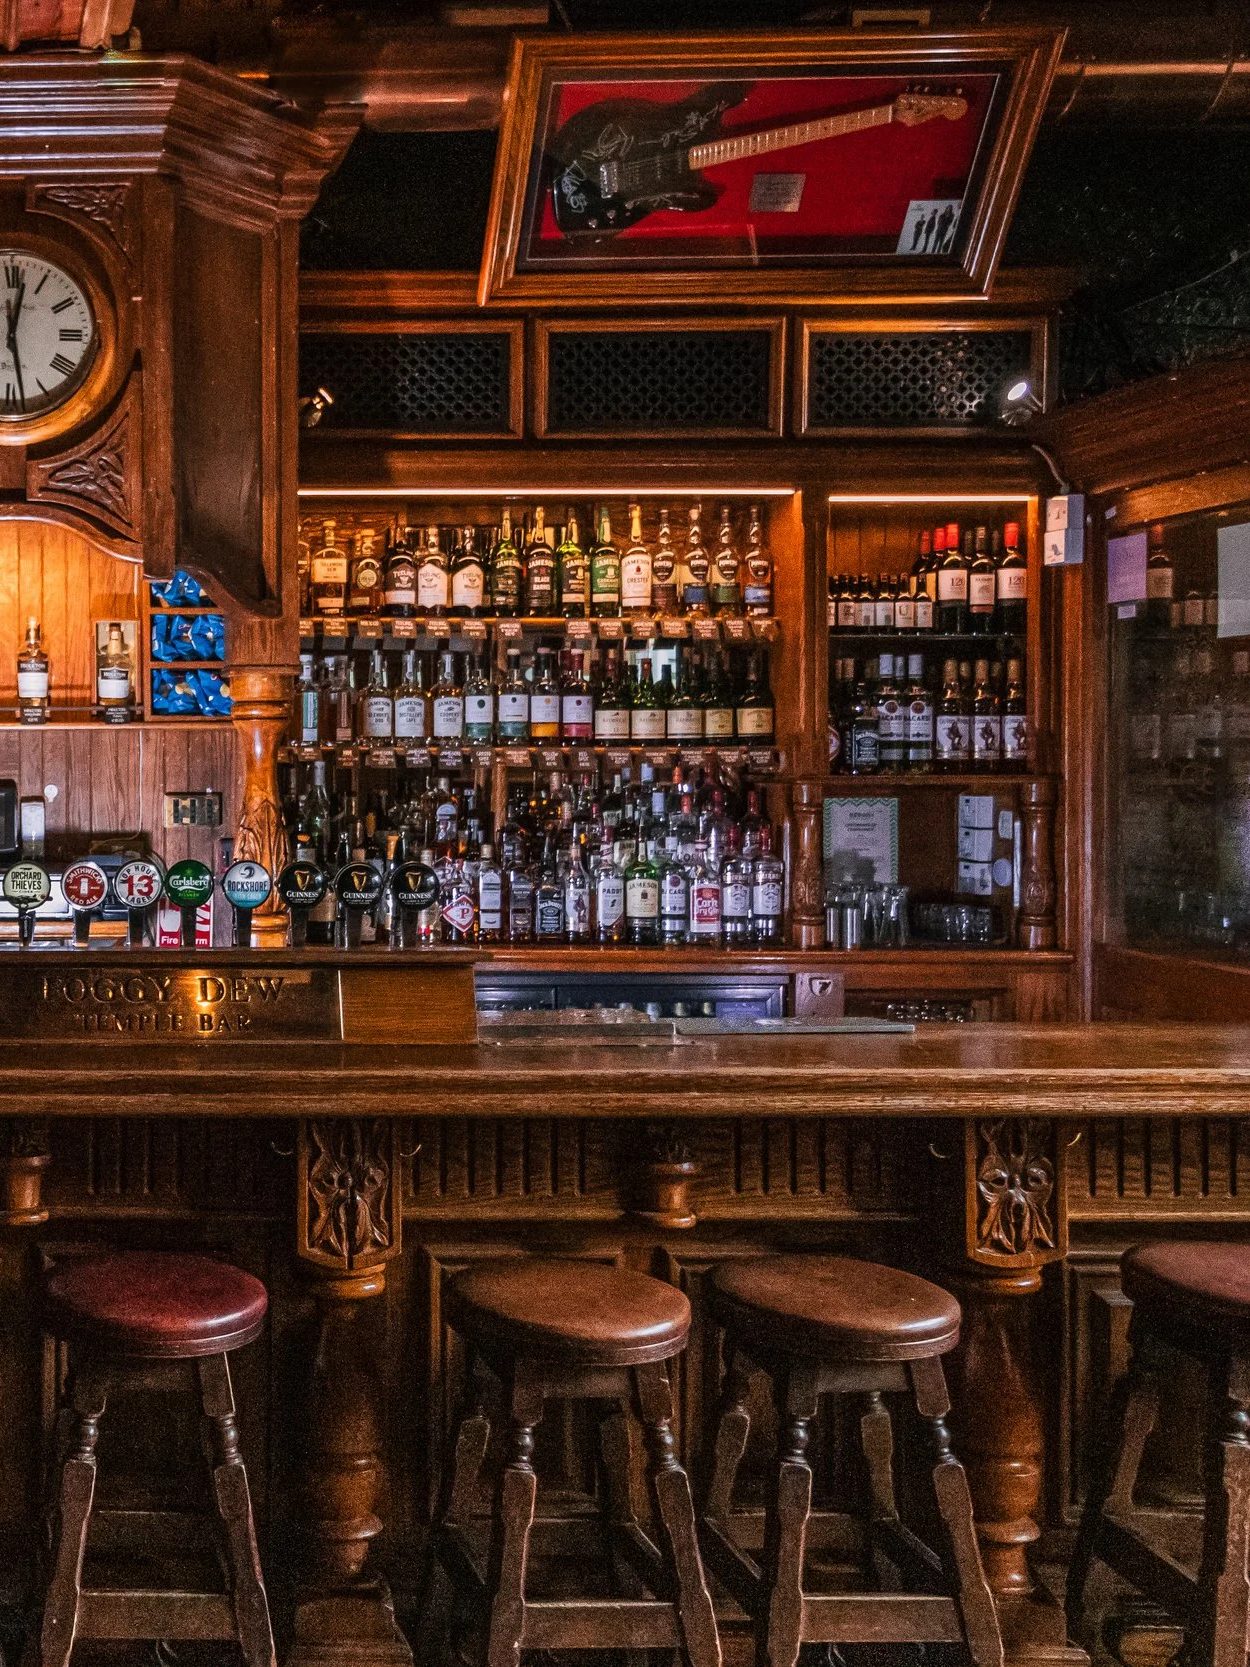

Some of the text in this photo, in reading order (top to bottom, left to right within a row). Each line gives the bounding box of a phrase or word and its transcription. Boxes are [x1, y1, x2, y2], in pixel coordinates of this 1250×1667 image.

[624, 559, 650, 567] JAMESON
[398, 700, 423, 708] JAMESON
[438, 700, 461, 708] JAMESON
[11, 871, 42, 881] ORCHARD
[119, 868, 132, 883] HOP
[11, 880, 42, 890] THIEVES
[125, 874, 154, 897] 13
[168, 874, 210, 889] Carlsberg
[227, 880, 268, 892] ROCKSHORE
[628, 880, 657, 890] JAMESON
[70, 894, 100, 906] RED ALE
[125, 895, 152, 905] LAGER
[286, 891, 319, 899] GUINNESS
[342, 891, 376, 900] GUINNESS
[398, 892, 432, 900] GUINNESS
[460, 908, 470, 919] P
[161, 936, 179, 945] Fire
[42, 976, 285, 1003] FOGGY DEW
[73, 1013, 253, 1033] TEMPLE BAR
